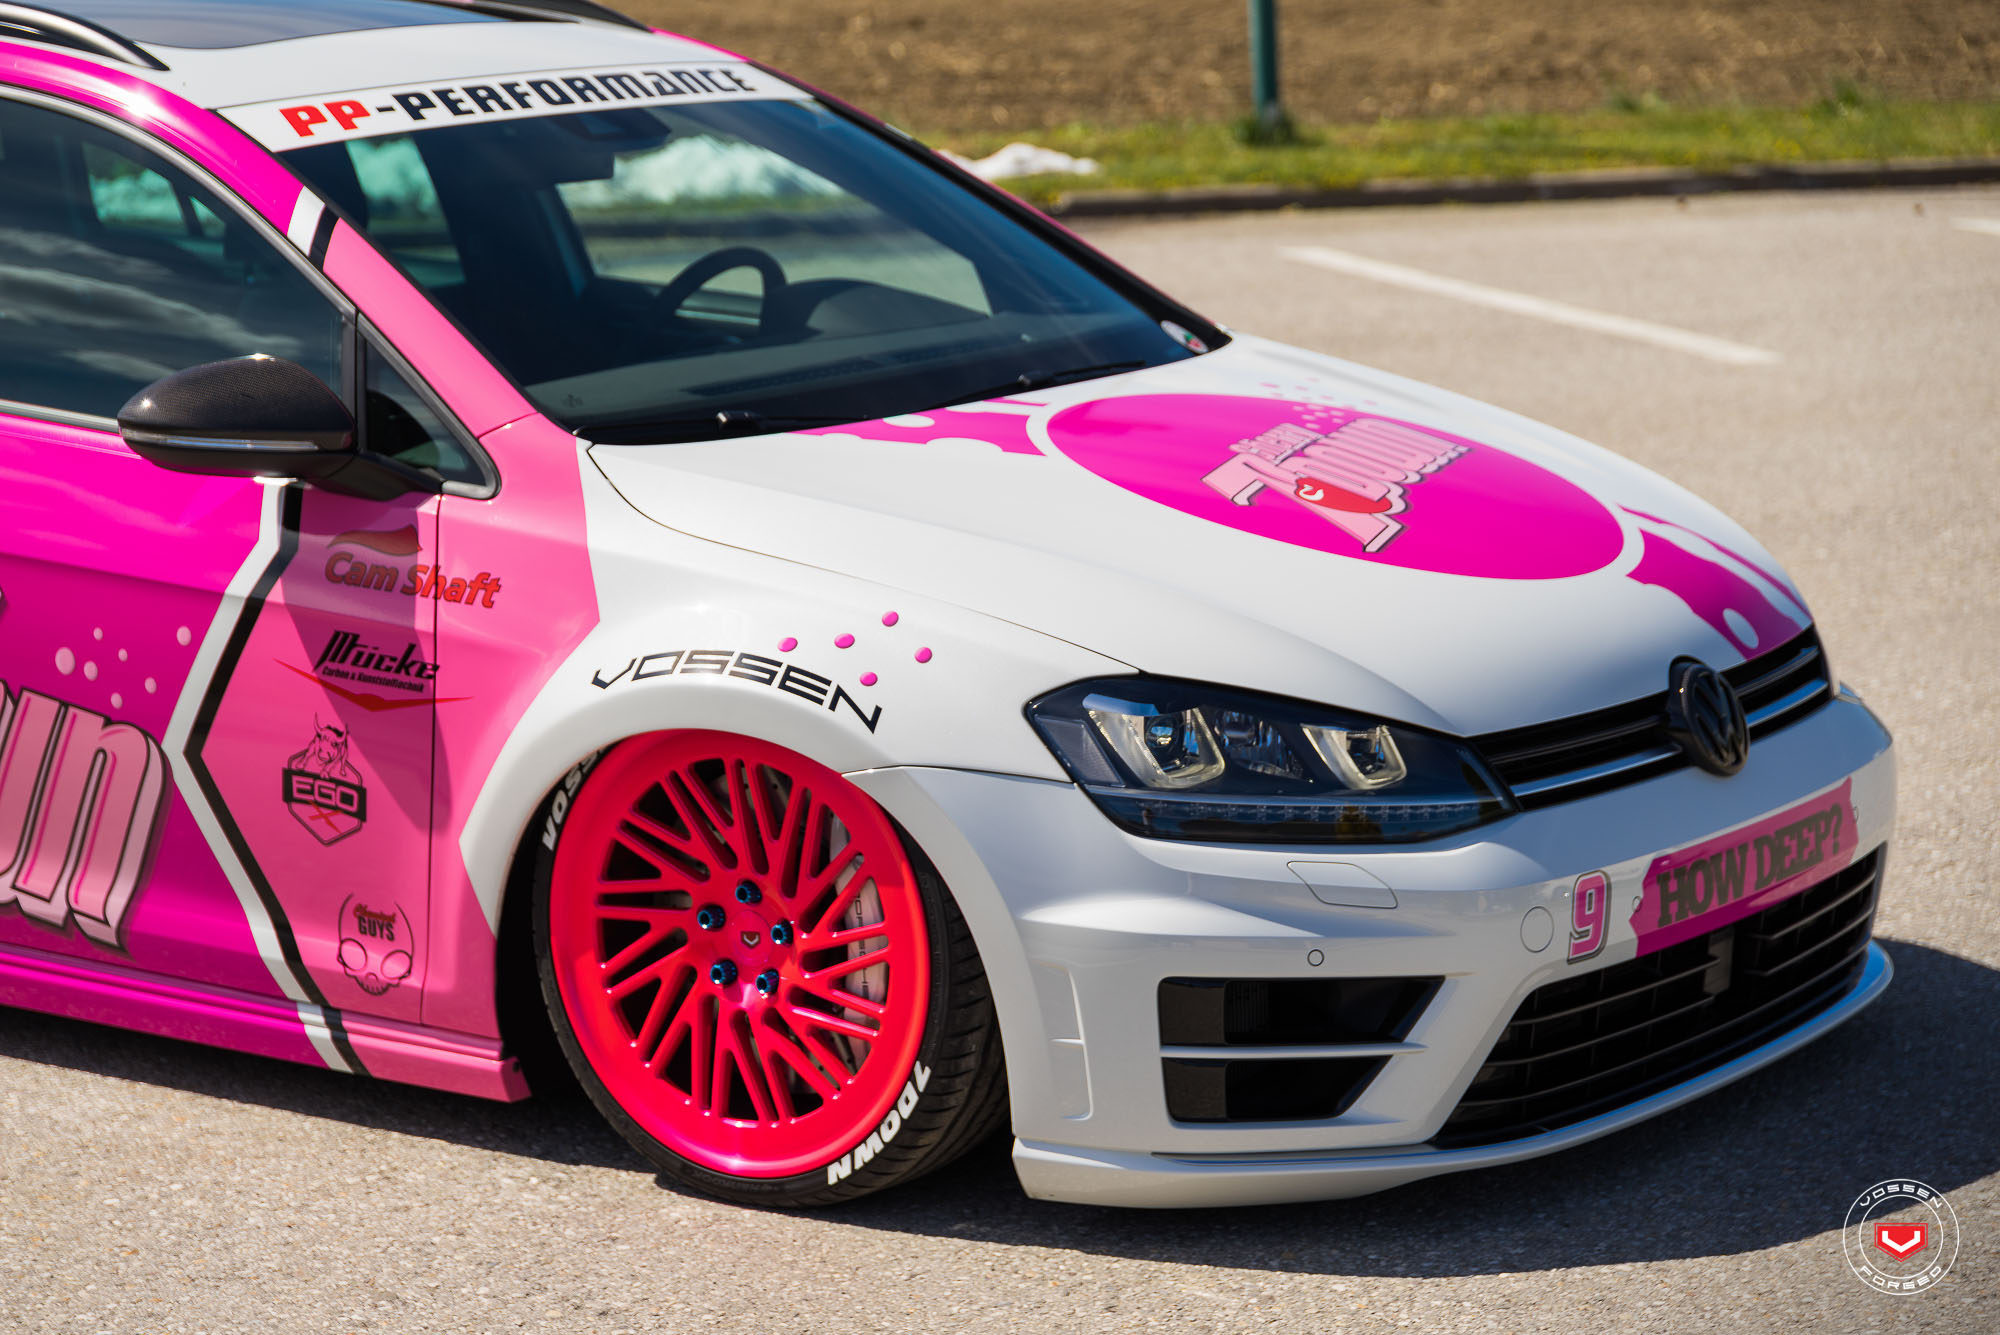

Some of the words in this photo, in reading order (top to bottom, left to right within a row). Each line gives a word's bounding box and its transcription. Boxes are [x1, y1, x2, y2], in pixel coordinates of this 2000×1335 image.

[324, 551, 400, 593] Cam
[400, 564, 502, 609] Shaft
[590, 650, 884, 735] VOSSEN
[291, 774, 360, 814] EGO
[1655, 841, 1750, 928] HOW
[1753, 803, 1843, 889] DEEP?
[357, 915, 395, 942] GUYS
[1567, 869, 1613, 965] 9
